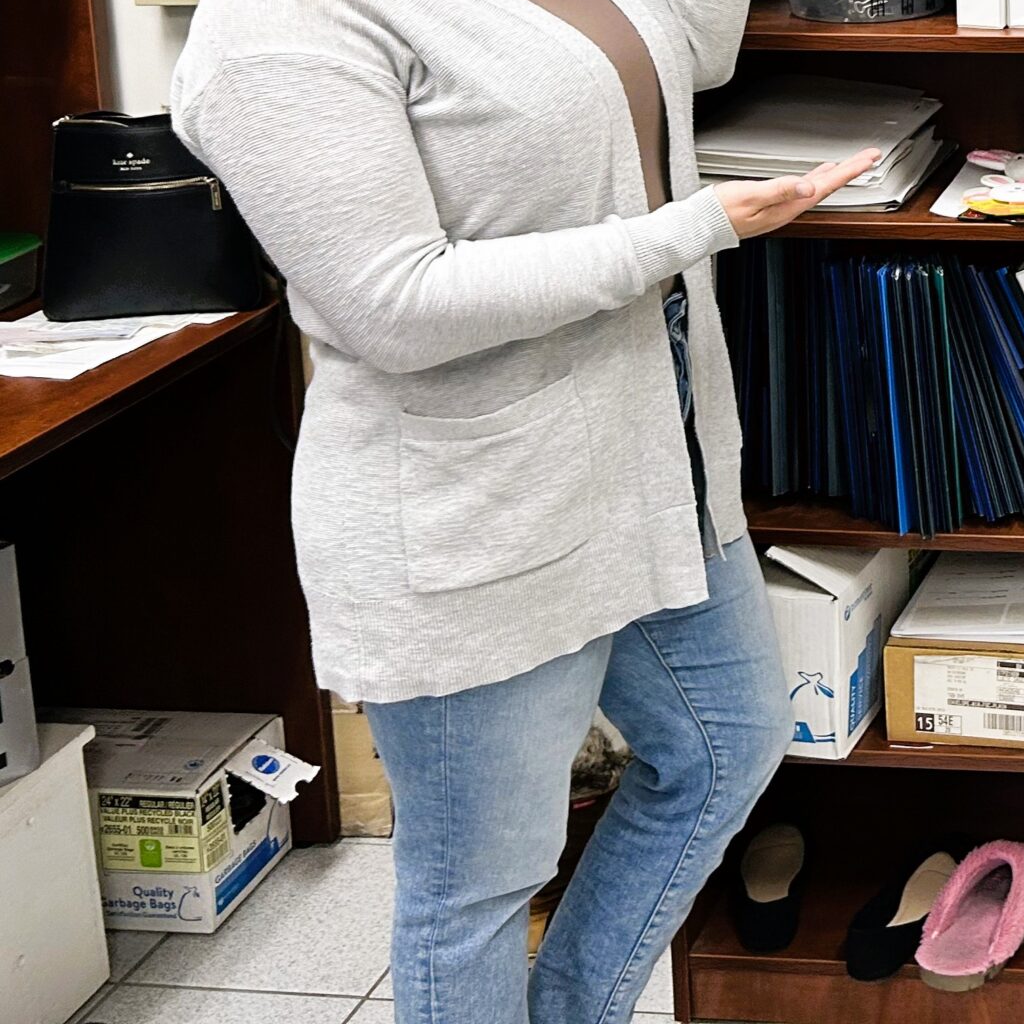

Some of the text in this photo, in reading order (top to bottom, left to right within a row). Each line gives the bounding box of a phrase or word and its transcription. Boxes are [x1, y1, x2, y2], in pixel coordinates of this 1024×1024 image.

[917, 715, 954, 732] 15 54E
[140, 809, 173, 817] RECYCLED
[243, 839, 258, 858] BAGS
[133, 886, 174, 900] Quality
[150, 898, 177, 912] Bags
